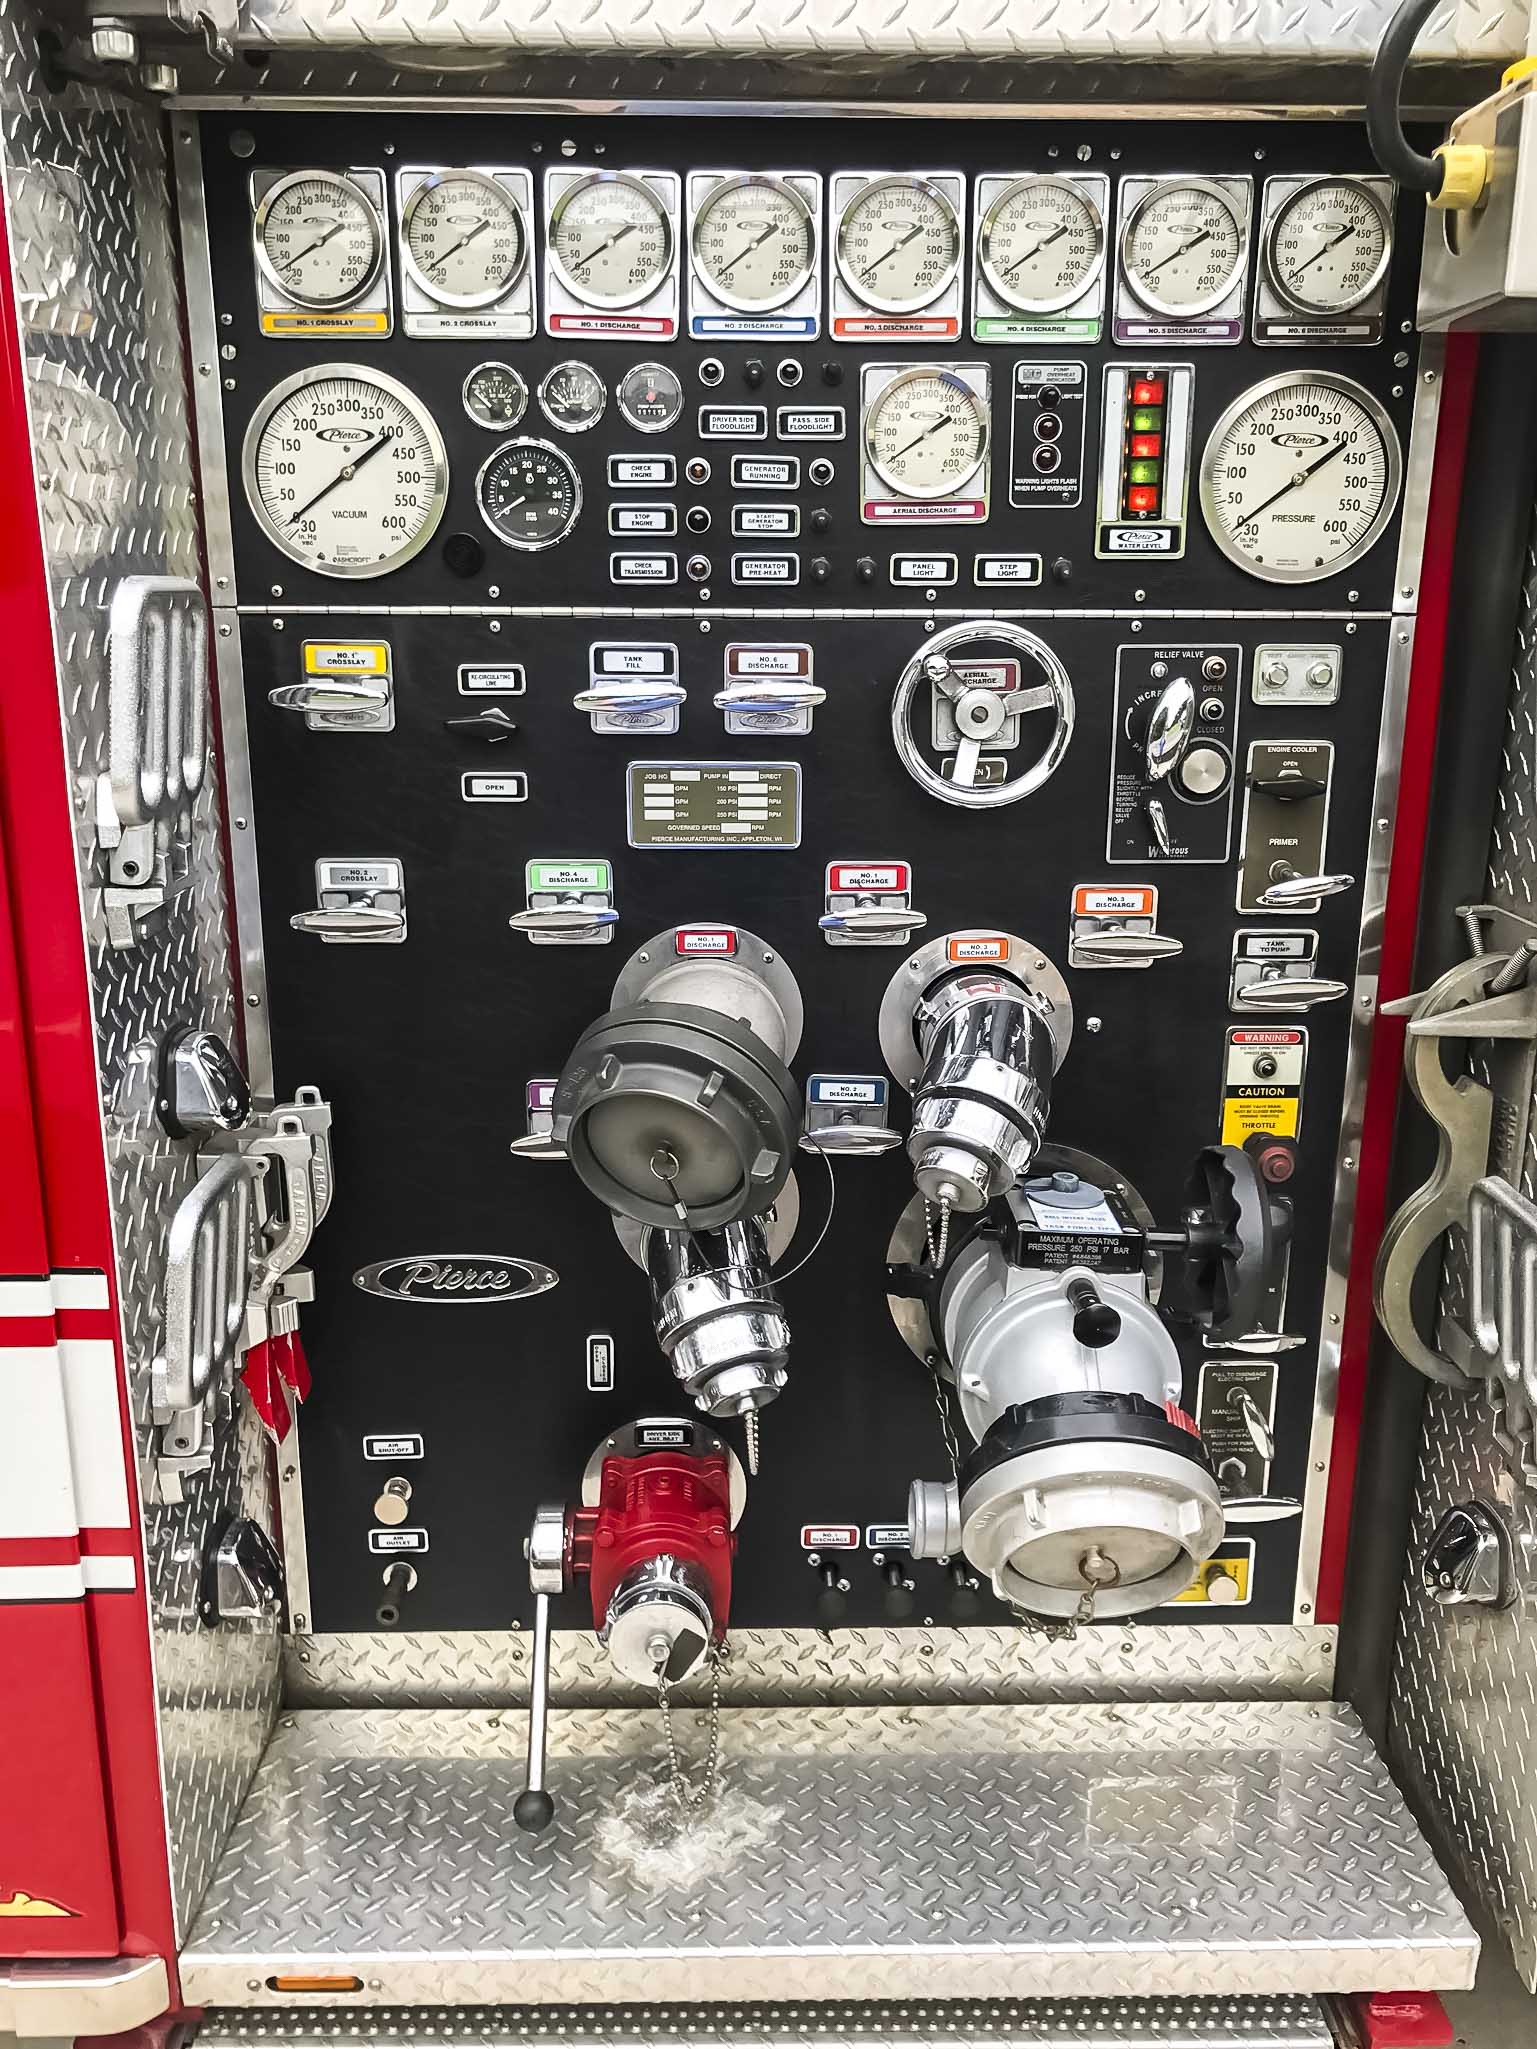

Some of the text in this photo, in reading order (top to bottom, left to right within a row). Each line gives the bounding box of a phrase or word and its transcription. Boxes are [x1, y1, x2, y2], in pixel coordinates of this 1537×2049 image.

[296, 319, 310, 327] NO.
[315, 319, 354, 327] CROSSLAY
[312, 403, 335, 416] 250
[336, 399, 360, 412] 300
[1295, 405, 1319, 417] 300
[361, 407, 384, 419] 350
[1271, 408, 1294, 420] 250
[1318, 412, 1341, 425] 350
[293, 419, 317, 431] 200
[1250, 423, 1274, 435] 200
[329, 429, 361, 440] Pierce
[379, 426, 404, 438] 400
[1333, 431, 1357, 443] 400
[281, 439, 300, 451] 150
[1284, 435, 1315, 445] Pierce
[392, 448, 415, 460] 450
[1236, 444, 1255, 456] 150
[1343, 453, 1365, 465] 450
[275, 463, 295, 474] 100
[509, 467, 518, 475] 15
[1227, 467, 1246, 478] 100
[397, 472, 420, 483] 500
[1344, 477, 1367, 488] 500
[280, 488, 295, 500] 50
[552, 491, 562, 499] 35
[1227, 492, 1242, 504] 50
[395, 495, 417, 507] 550
[1339, 499, 1360, 511] 550
[332, 511, 367, 519] VACUUM
[1272, 515, 1315, 523] PRESSURE
[301, 520, 316, 532] 30
[382, 517, 406, 528] 600
[1323, 520, 1347, 532] 600
[1244, 524, 1258, 536] 30
[1244, 1034, 1289, 1042] WARNING
[1239, 1088, 1285, 1096] CAUTION
[1040, 1235, 1119, 1246] MAXIMUM OPERATING
[1028, 1243, 1066, 1251] PRESSURE
[398, 1261, 511, 1294] Pierce
